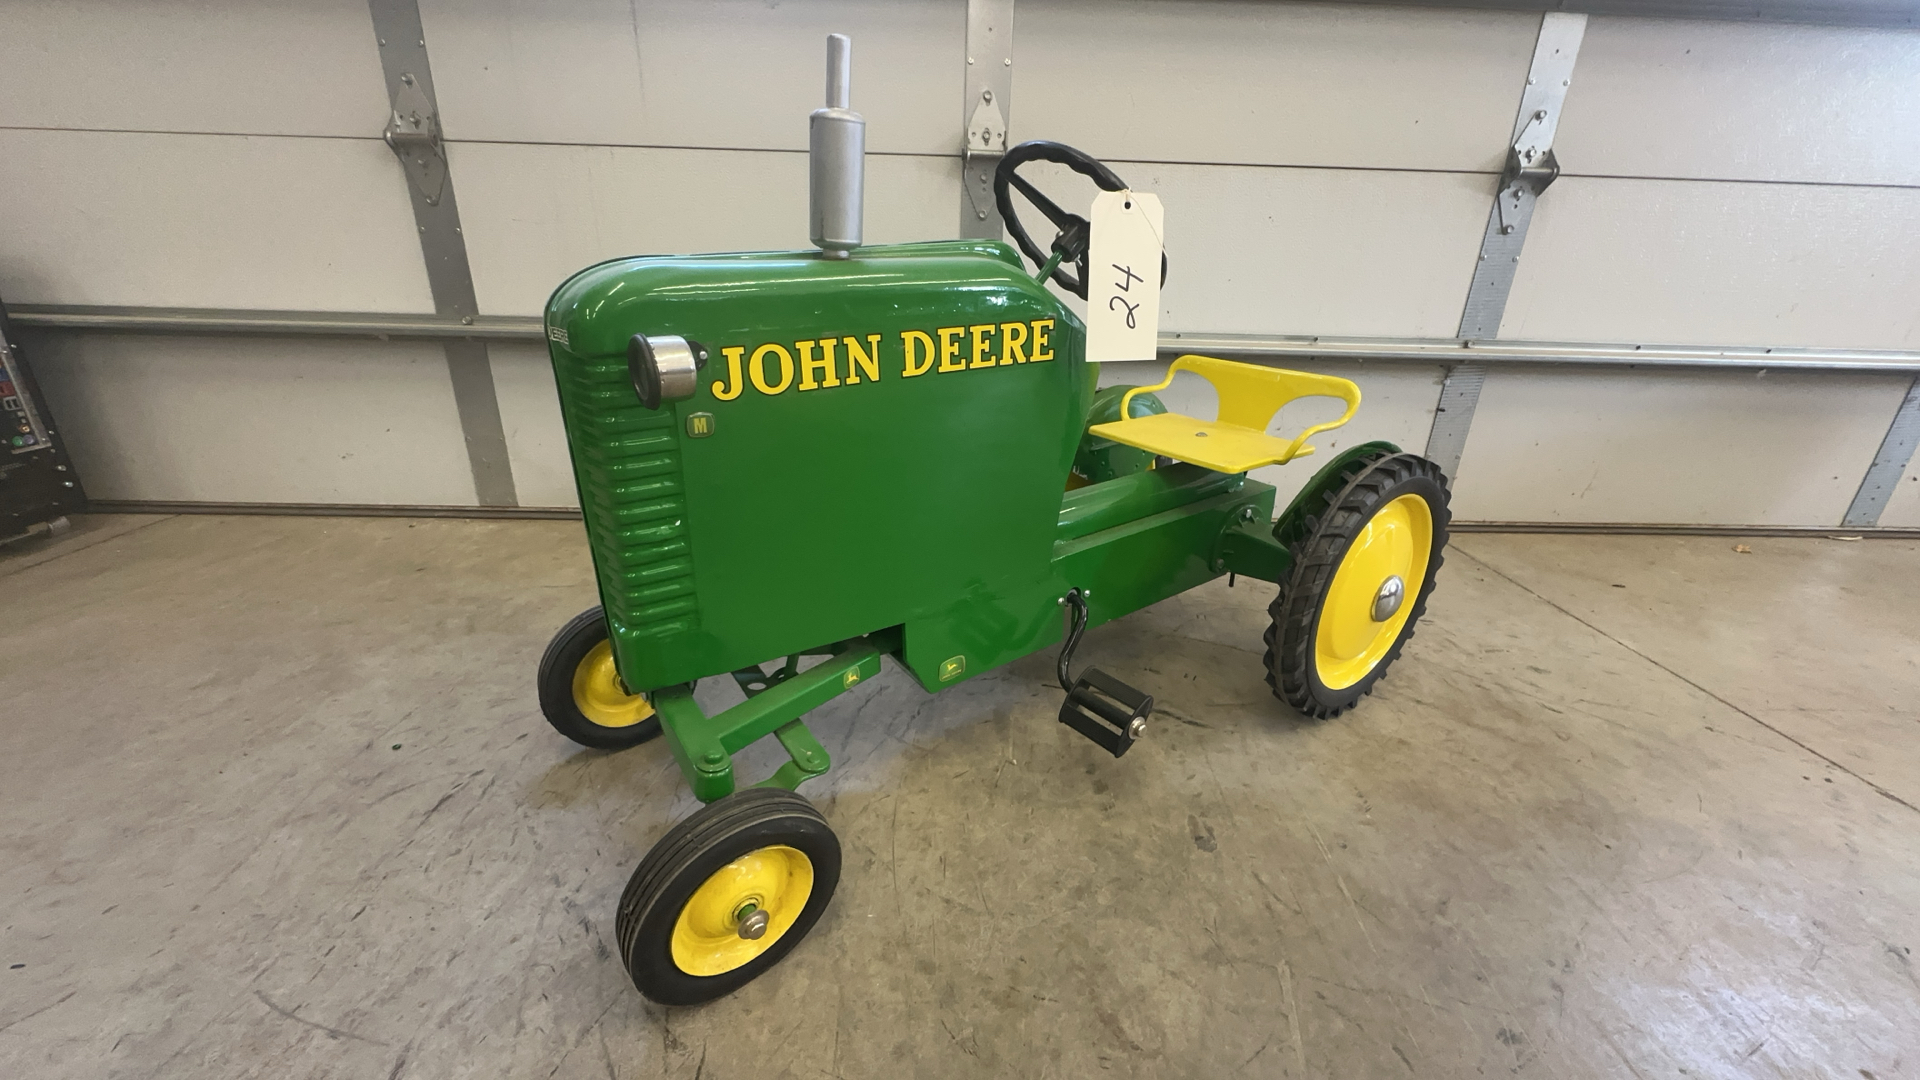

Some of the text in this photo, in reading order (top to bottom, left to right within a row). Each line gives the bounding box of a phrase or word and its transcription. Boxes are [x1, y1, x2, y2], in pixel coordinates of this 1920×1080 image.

[1109, 263, 1144, 330] 24
[711, 319, 1055, 402] JOHN DEERE
[693, 417, 708, 434] M
